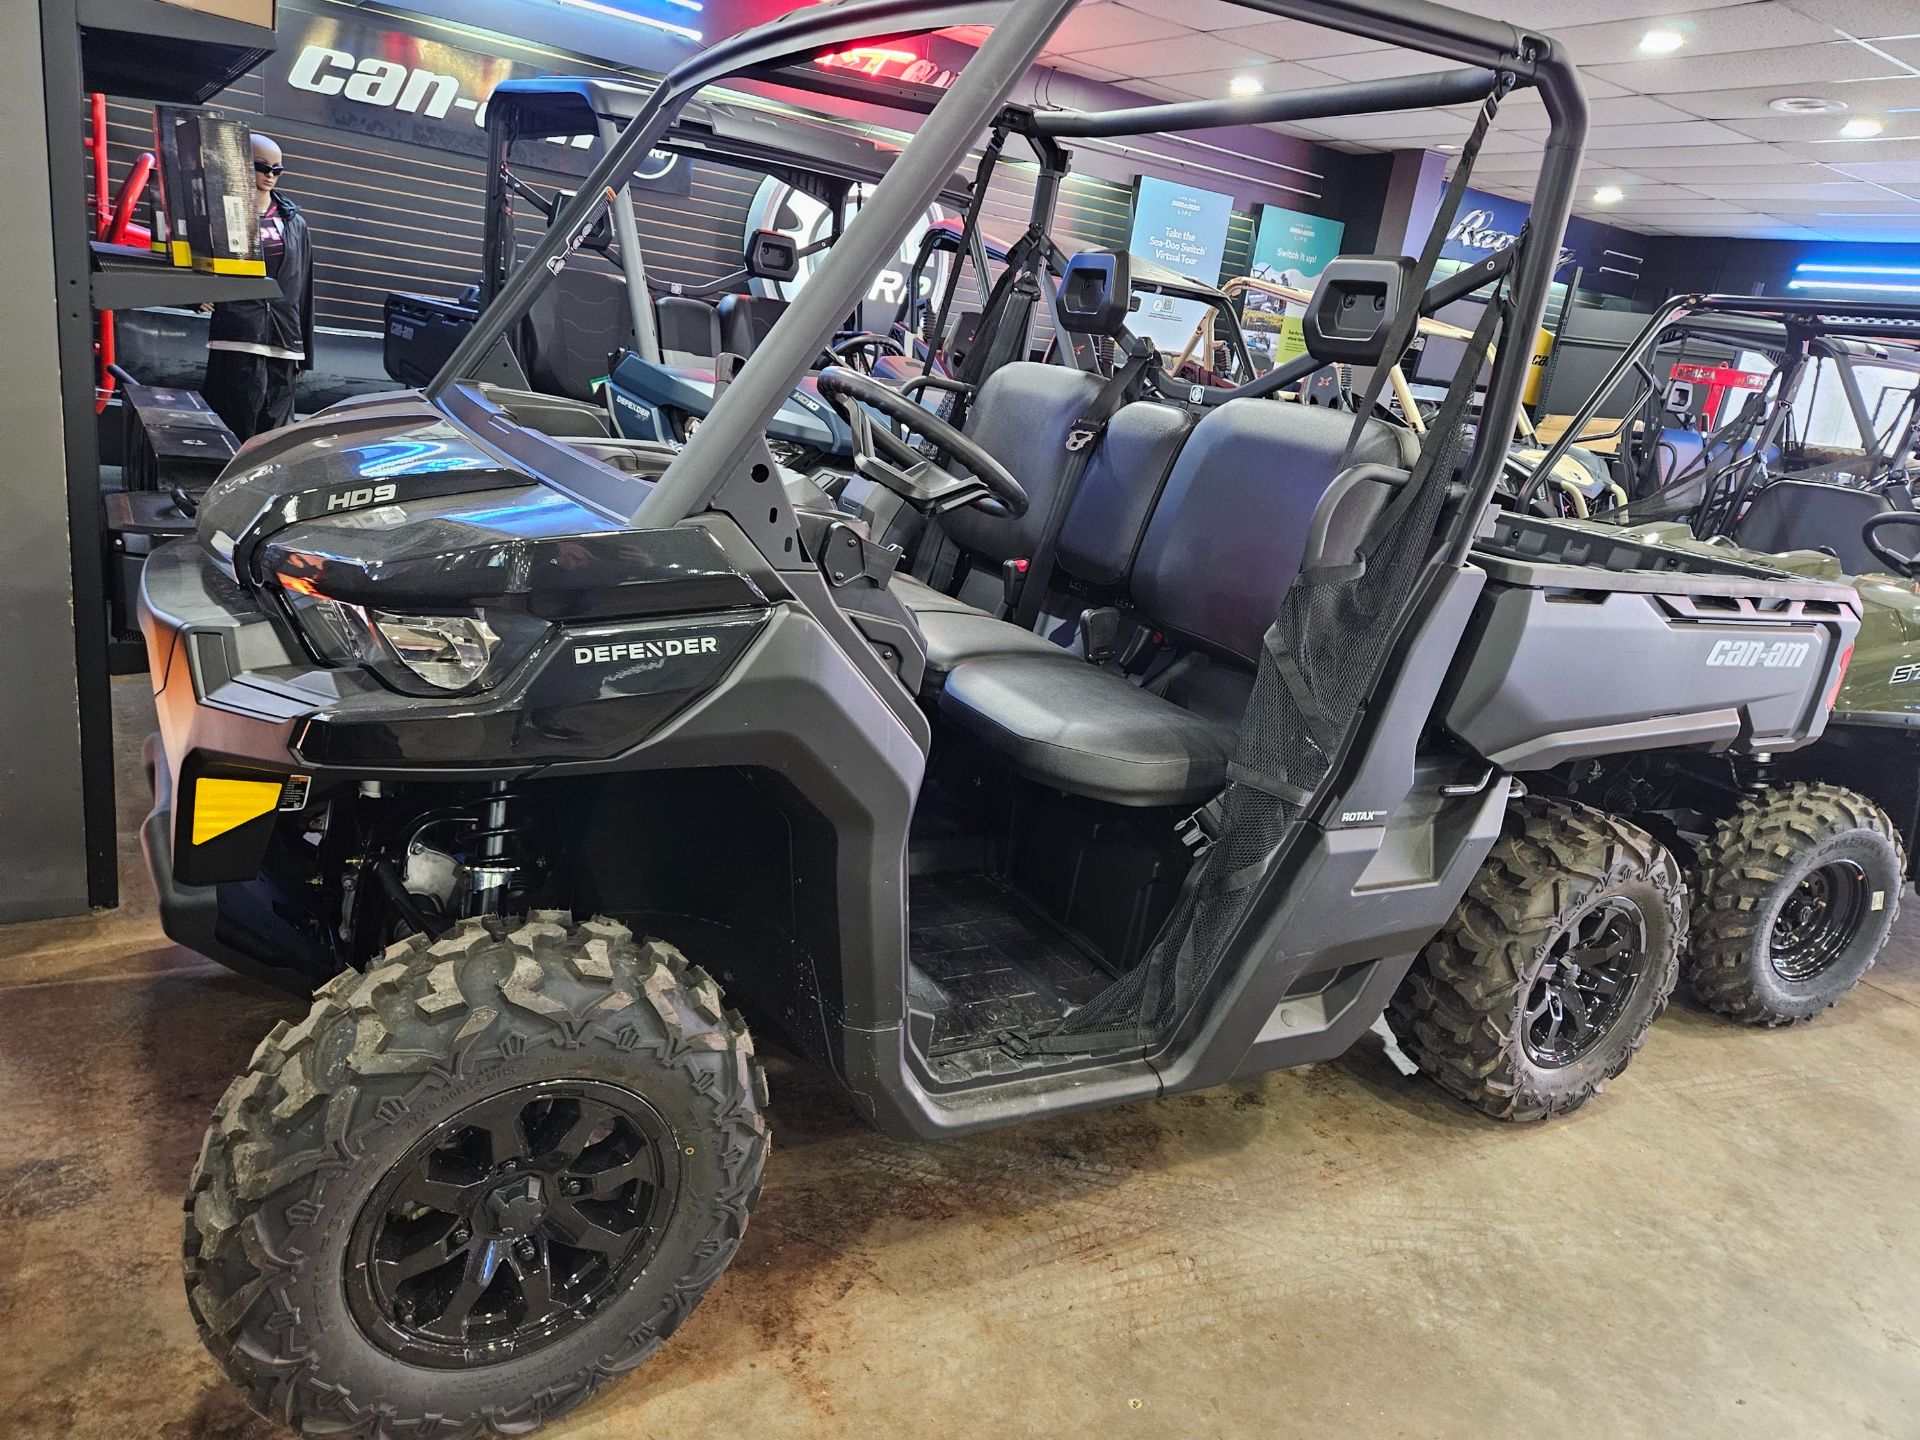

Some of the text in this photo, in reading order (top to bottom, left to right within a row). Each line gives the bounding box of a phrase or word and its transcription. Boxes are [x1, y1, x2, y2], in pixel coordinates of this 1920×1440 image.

[1165, 227, 1196, 241] Take the
[1149, 236, 1206, 256] Sea-Doo Switch
[1277, 247, 1317, 265] Switch it up!
[1155, 249, 1198, 265] Virtual Tour
[616, 394, 650, 419] DEFENDER
[793, 391, 820, 412] HD10
[327, 483, 397, 511] HD9
[574, 636, 718, 665] DEFENDER
[1705, 640, 1810, 668] can-am
[1341, 811, 1375, 823] ROTAX
